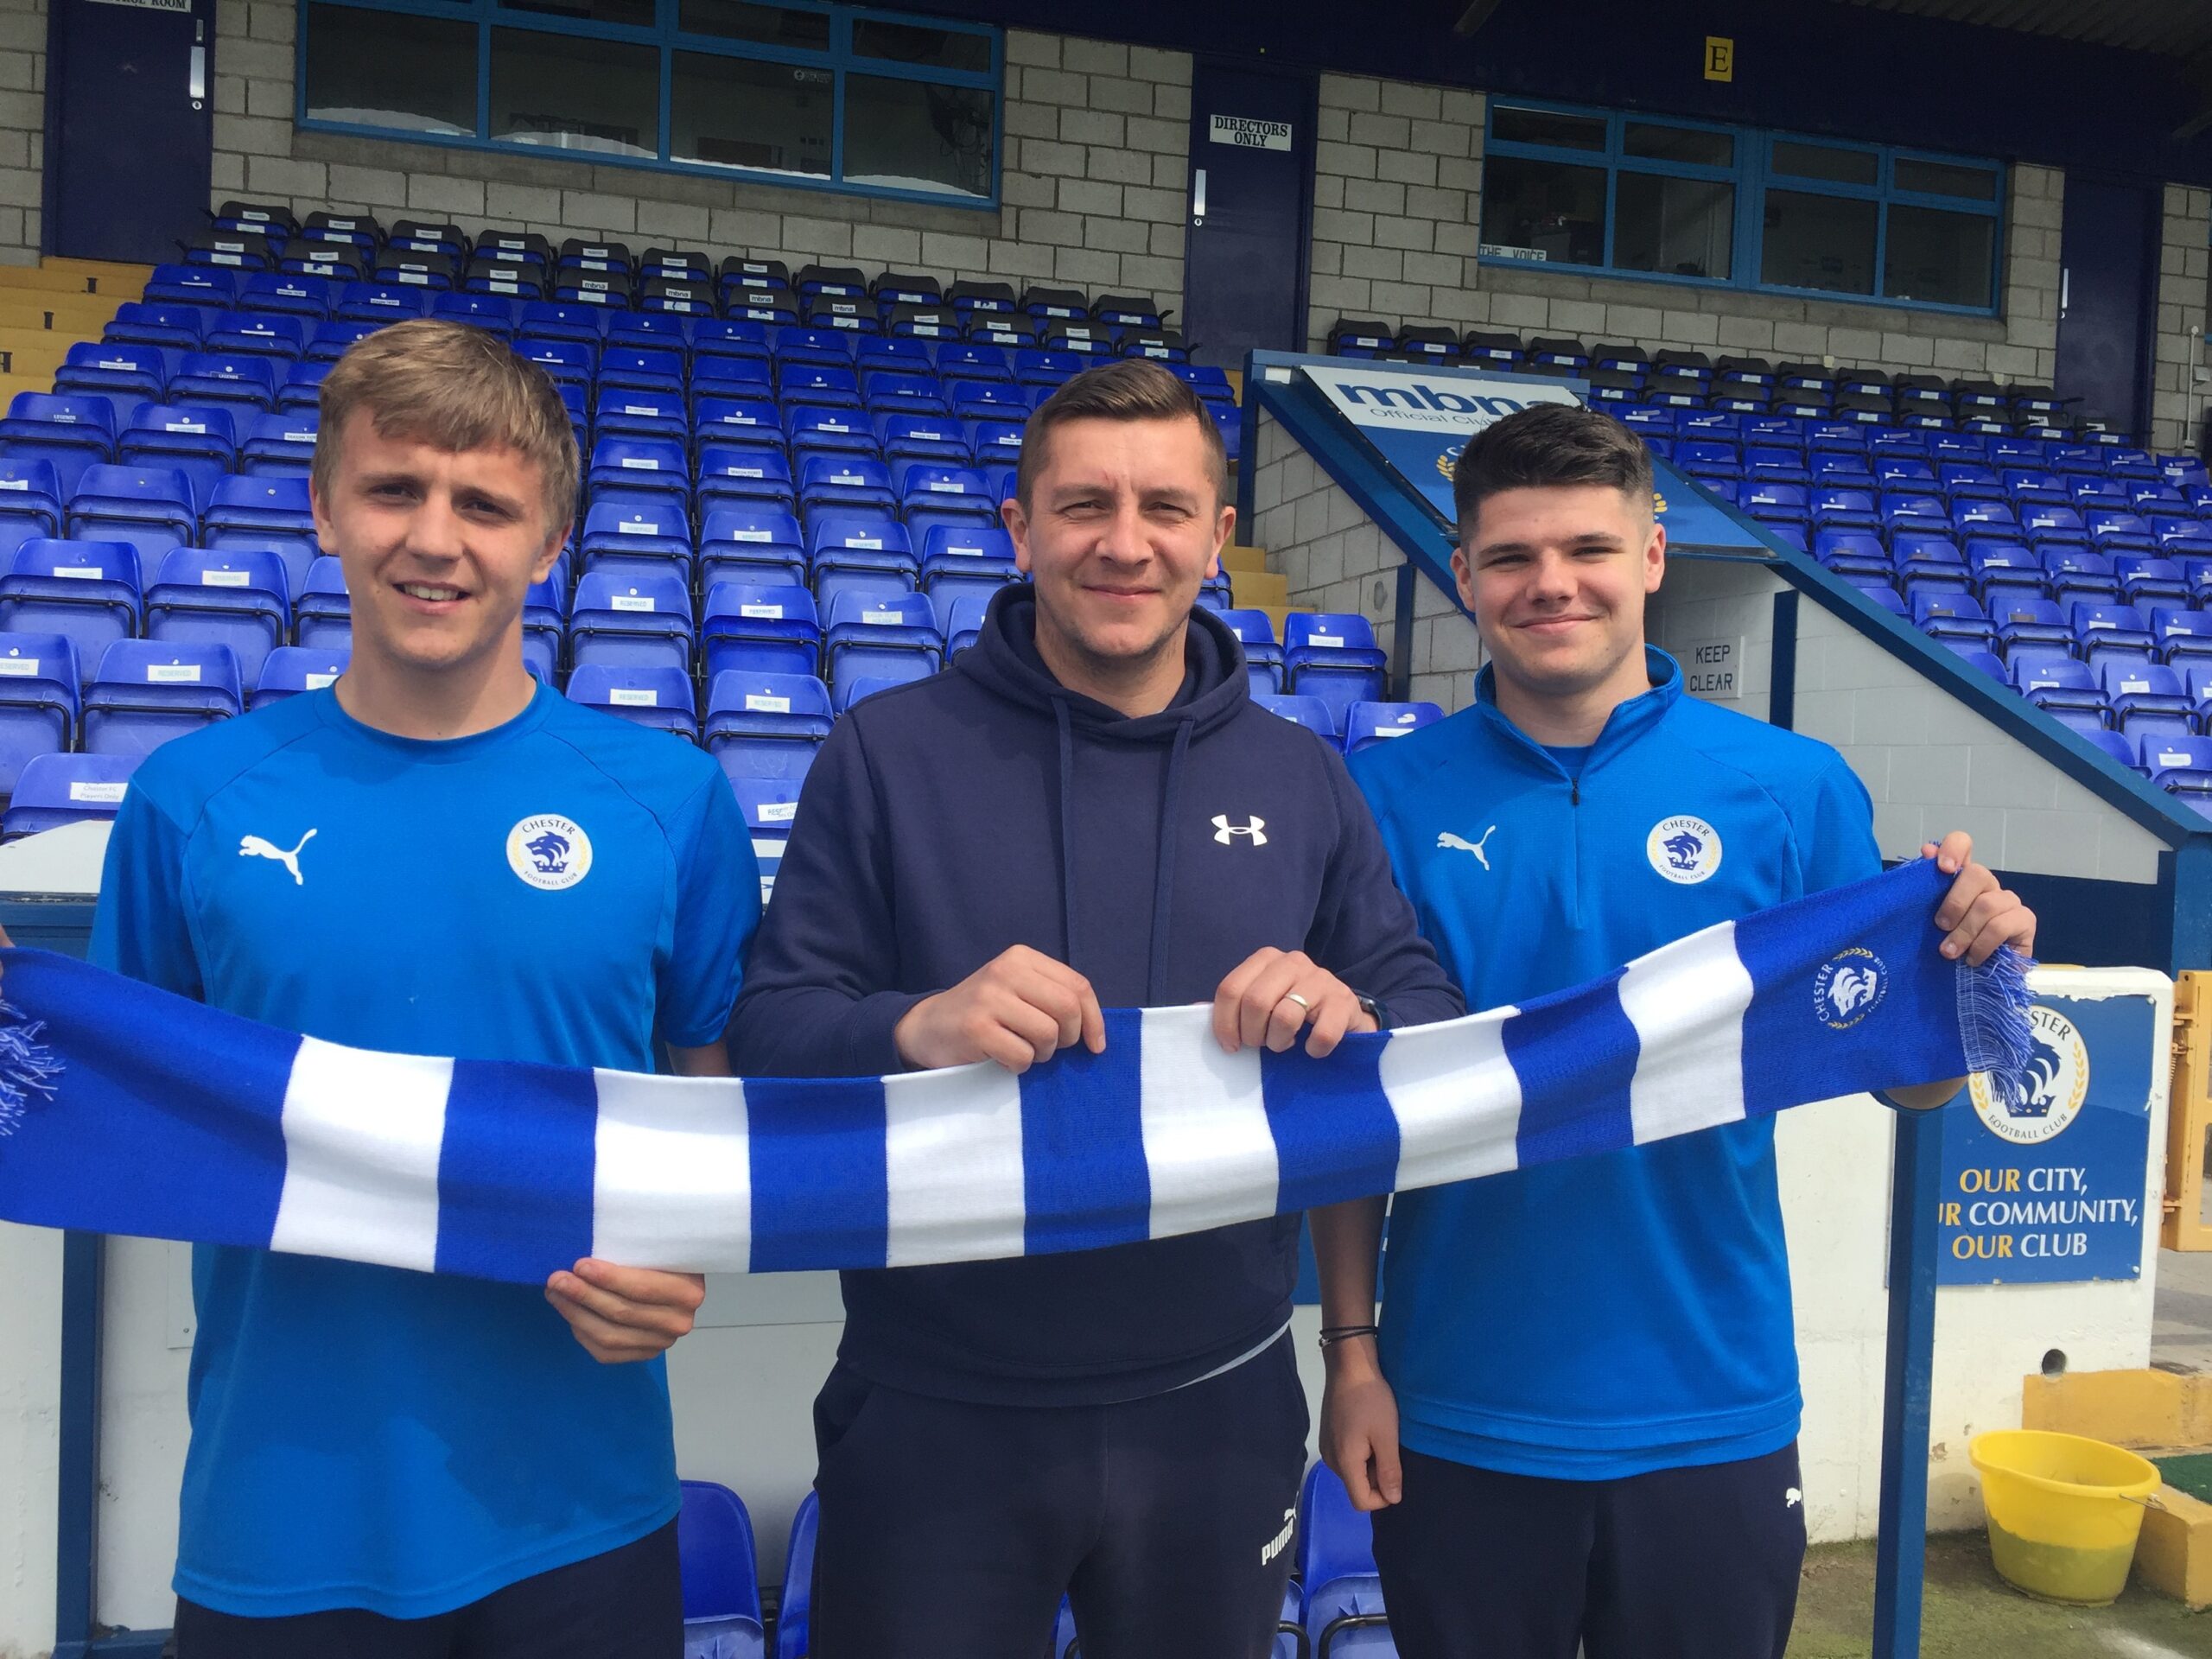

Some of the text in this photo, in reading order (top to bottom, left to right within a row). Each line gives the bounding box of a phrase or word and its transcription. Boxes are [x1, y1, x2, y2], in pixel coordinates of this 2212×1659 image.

[1709, 45, 1730, 73] E
[1215, 116, 1287, 137] DIRECTORS
[1234, 131, 1268, 147] ONLY
[1480, 245, 1544, 260] THE VOICE
[668, 289, 689, 298] mbna
[1335, 384, 1554, 416] mbn
[1370, 408, 1448, 423] Official
[1695, 645, 1731, 664] KEEP
[1690, 673, 1732, 692] CLEAR
[522, 818, 576, 836] CHESTER
[1662, 819, 1710, 836] CHESTER
[524, 870, 578, 887] FOOTBALL CLUB
[1659, 864, 1706, 880] FOOTBALL CLUB
[1813, 963, 1834, 1022] CHESTER
[2031, 1010, 2071, 1041] STER
[1987, 1112, 2069, 1139] FOOTBALL CLUB
[1959, 1167, 2088, 1195] OUR CITY,
[1969, 1198, 2139, 1226] COMMUNITY,
[1952, 1232, 2088, 1259] OUR CLUB
[1262, 1517, 1294, 1566] PUMA
